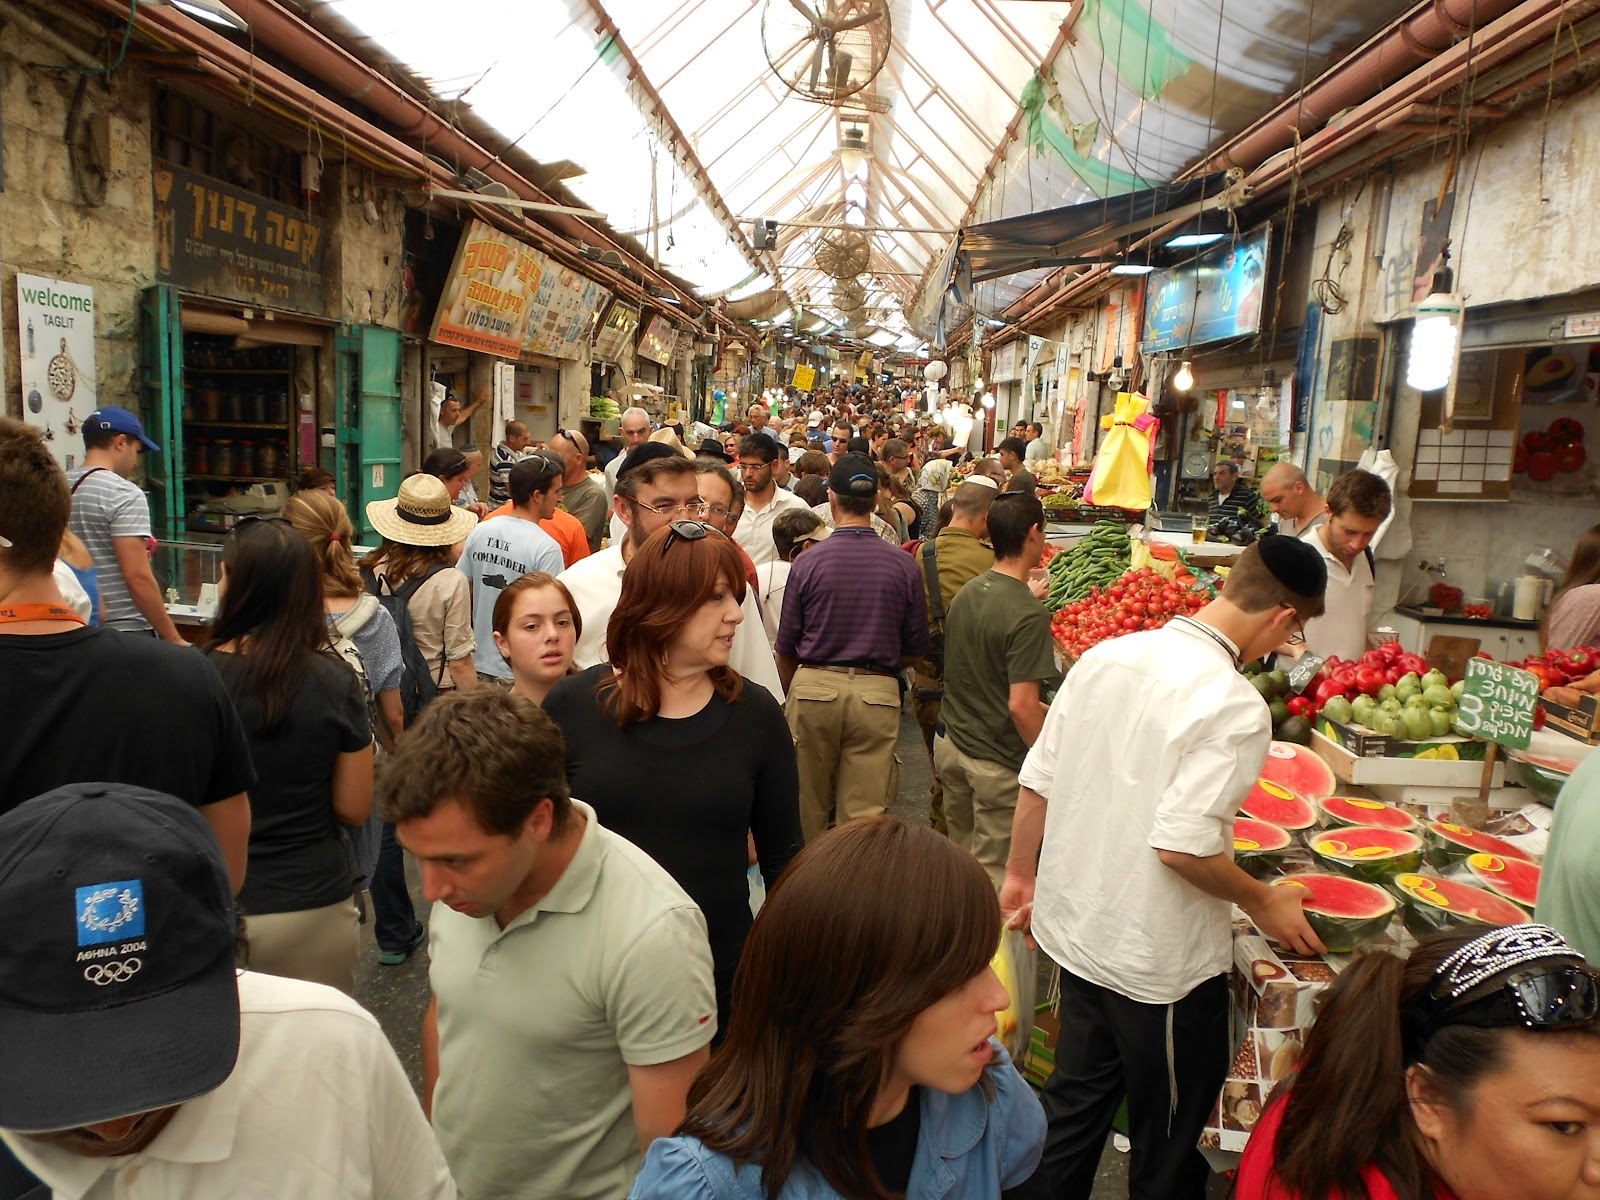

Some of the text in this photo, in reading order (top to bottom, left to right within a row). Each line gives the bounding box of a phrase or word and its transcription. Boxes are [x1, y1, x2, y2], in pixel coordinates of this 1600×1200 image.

[265, 210, 320, 265] קפה
[461, 240, 508, 277] משק
[22, 287, 91, 313] welcome
[43, 314, 74, 329] TAGLIT
[1456, 693, 1484, 731] 3
[120, 941, 147, 955] 2004
